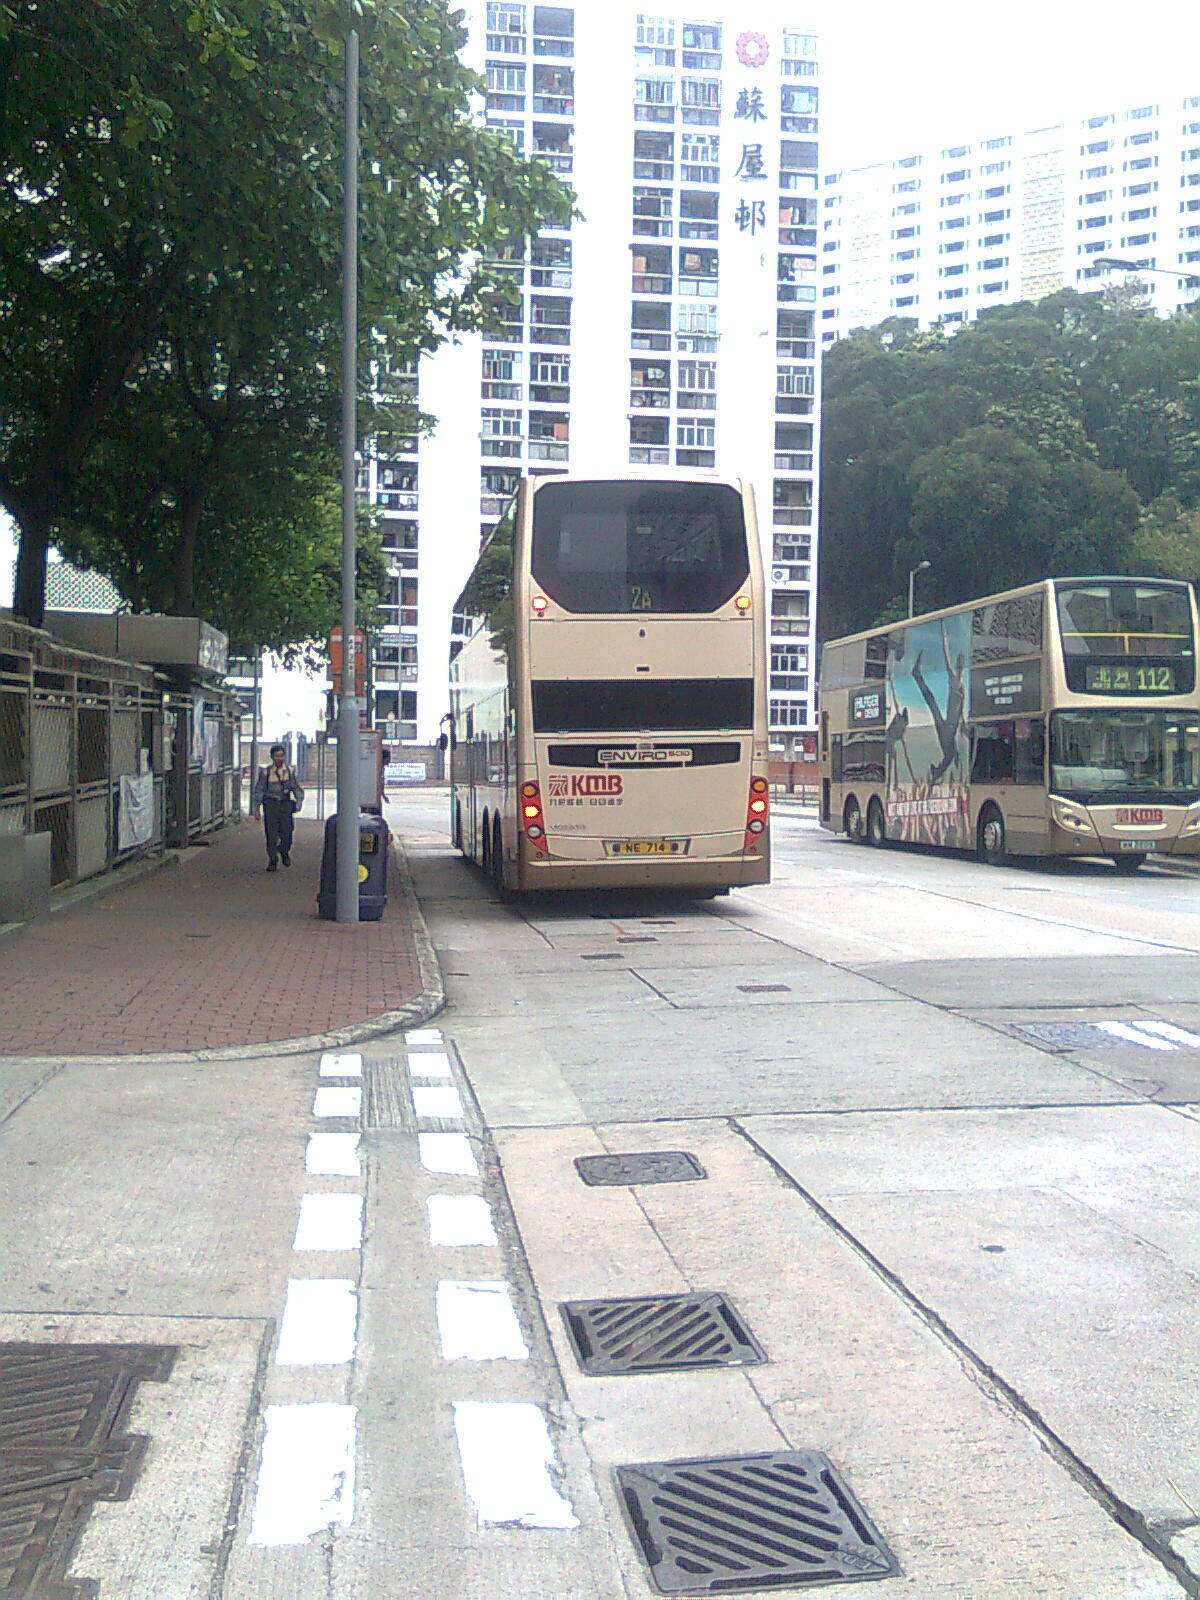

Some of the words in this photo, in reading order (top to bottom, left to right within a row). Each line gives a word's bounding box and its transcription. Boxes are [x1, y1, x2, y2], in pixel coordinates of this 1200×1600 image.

[733, 86, 768, 236] 蘇屋邨
[632, 586, 652, 609] 2A
[1136, 667, 1170, 690] 112
[571, 775, 624, 796] KMB
[1130, 808, 1163, 823] KMB
[625, 843, 640, 853] NE
[647, 843, 665, 853] 714
